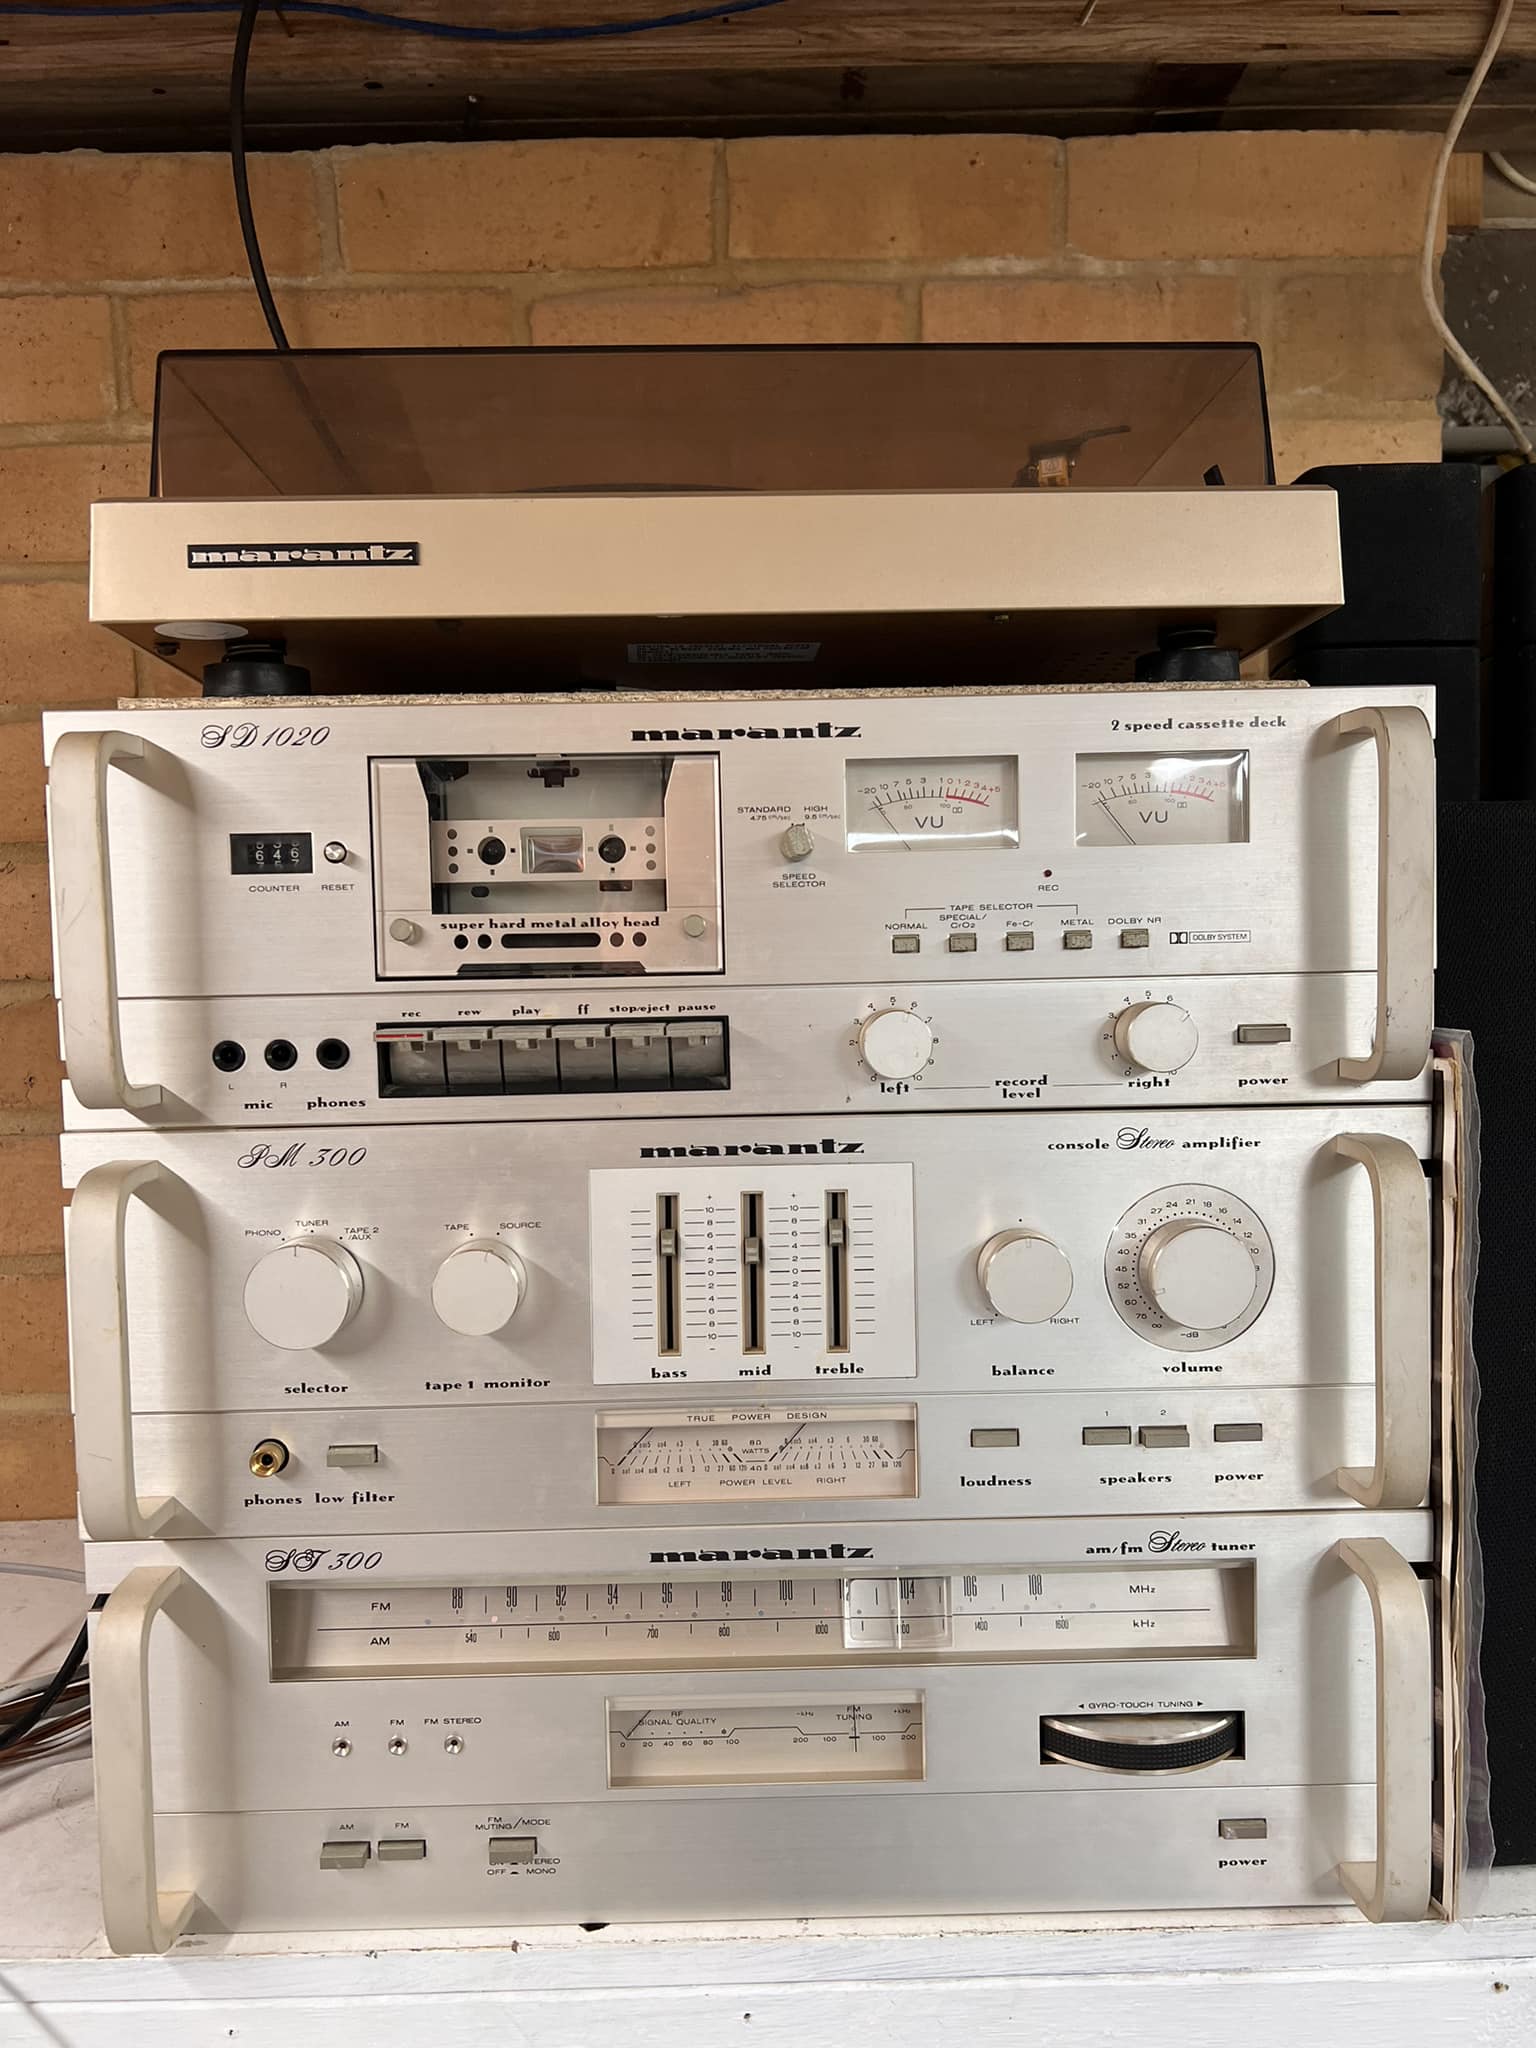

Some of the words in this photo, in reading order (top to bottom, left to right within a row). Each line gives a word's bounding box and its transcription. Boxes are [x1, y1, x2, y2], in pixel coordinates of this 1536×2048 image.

[191, 545, 414, 564] marantz
[1111, 719, 1120, 731] 2
[1124, 717, 1173, 733] speed
[1177, 719, 1245, 730] cassette
[1249, 715, 1287, 728] deck
[631, 722, 862, 742] marantz
[737, 805, 792, 814] STANDARD
[803, 805, 828, 813] HIGH
[914, 815, 944, 829] VU
[1138, 810, 1168, 824] VU
[782, 872, 816, 880] SPEED
[248, 884, 300, 893] COUNTER
[321, 883, 355, 892] RESET
[1037, 884, 1059, 892] REC
[950, 904, 974, 912] TAPE
[979, 902, 1033, 911] SELECTOR
[440, 921, 486, 934] super
[488, 917, 526, 929] hard
[531, 917, 576, 929] metal
[579, 916, 620, 931] alloy
[623, 915, 660, 927] head
[884, 922, 928, 931] NORMAL
[1060, 918, 1094, 926] METAL
[1107, 917, 1143, 925] DOLBY
[1146, 916, 1162, 924] NR
[512, 1005, 541, 1017] play
[577, 1003, 590, 1015] ff
[677, 1004, 716, 1013] pause
[228, 1083, 235, 1091] L
[279, 1081, 288, 1089] R
[994, 1074, 1049, 1088] record
[1127, 1075, 1171, 1090] right
[1238, 1077, 1289, 1088] power
[879, 1081, 910, 1096] left
[1001, 1087, 1041, 1100] level
[244, 1099, 273, 1110] mic
[307, 1096, 366, 1111] phones
[1047, 1138, 1110, 1150] console
[1115, 1126, 1175, 1151] Stereo
[1181, 1135, 1261, 1151] amplifier
[639, 1138, 865, 1159] marantz
[308, 1147, 368, 1167] 300
[1166, 1200, 1178, 1208] 24
[295, 1219, 329, 1227] TUNER
[443, 1223, 470, 1231] TAPE
[499, 1221, 542, 1230] SOURCE
[244, 1229, 282, 1237] PHONO
[372, 1226, 380, 1234] 2
[970, 1318, 994, 1326] LEFT
[1049, 1316, 1080, 1325] RIGHT
[651, 1367, 688, 1379] bass
[738, 1364, 772, 1377] mid
[815, 1362, 865, 1375] treble
[991, 1364, 1055, 1377] balance
[1162, 1361, 1223, 1373] volume
[284, 1382, 349, 1394] selector
[425, 1381, 463, 1393] tape
[468, 1380, 474, 1389] 1
[483, 1378, 551, 1390] monitor
[732, 1413, 771, 1421] POWER
[787, 1412, 827, 1420] DESIGN
[762, 1478, 792, 1486] LEVEL
[960, 1474, 1032, 1487] loudness
[1099, 1471, 1172, 1486] speakers
[1214, 1470, 1264, 1484] power
[244, 1493, 302, 1508] phones
[315, 1492, 345, 1504] low
[352, 1491, 396, 1505] filter
[1085, 1541, 1143, 1555] am/fm
[1148, 1530, 1207, 1553] Stereo
[1211, 1542, 1256, 1552] tuner
[649, 1543, 874, 1563] marantz
[328, 1551, 383, 1571] 300
[371, 1602, 391, 1611] FM
[452, 1587, 464, 1609] 88
[506, 1585, 518, 1607] 90
[555, 1584, 567, 1606] 92
[607, 1583, 619, 1605] 94
[661, 1582, 673, 1604] 96
[721, 1581, 732, 1602] 98
[779, 1579, 794, 1601] 100
[900, 1579, 915, 1600] 104
[963, 1575, 978, 1597] 106
[1028, 1574, 1043, 1596] 108
[1129, 1584, 1156, 1594] MHz
[370, 1637, 390, 1646] AM
[646, 1628, 659, 1639] 700
[718, 1626, 730, 1637] 800
[1133, 1619, 1156, 1628] kHz
[1088, 1701, 1154, 1710] GYRO-TOUCH
[1157, 1700, 1194, 1708] TUNING
[334, 1720, 350, 1728] AM
[443, 1716, 482, 1725] STEREO
[339, 1823, 355, 1831] AM
[1218, 1859, 1268, 1869] power
[525, 1867, 557, 1875] MONO
